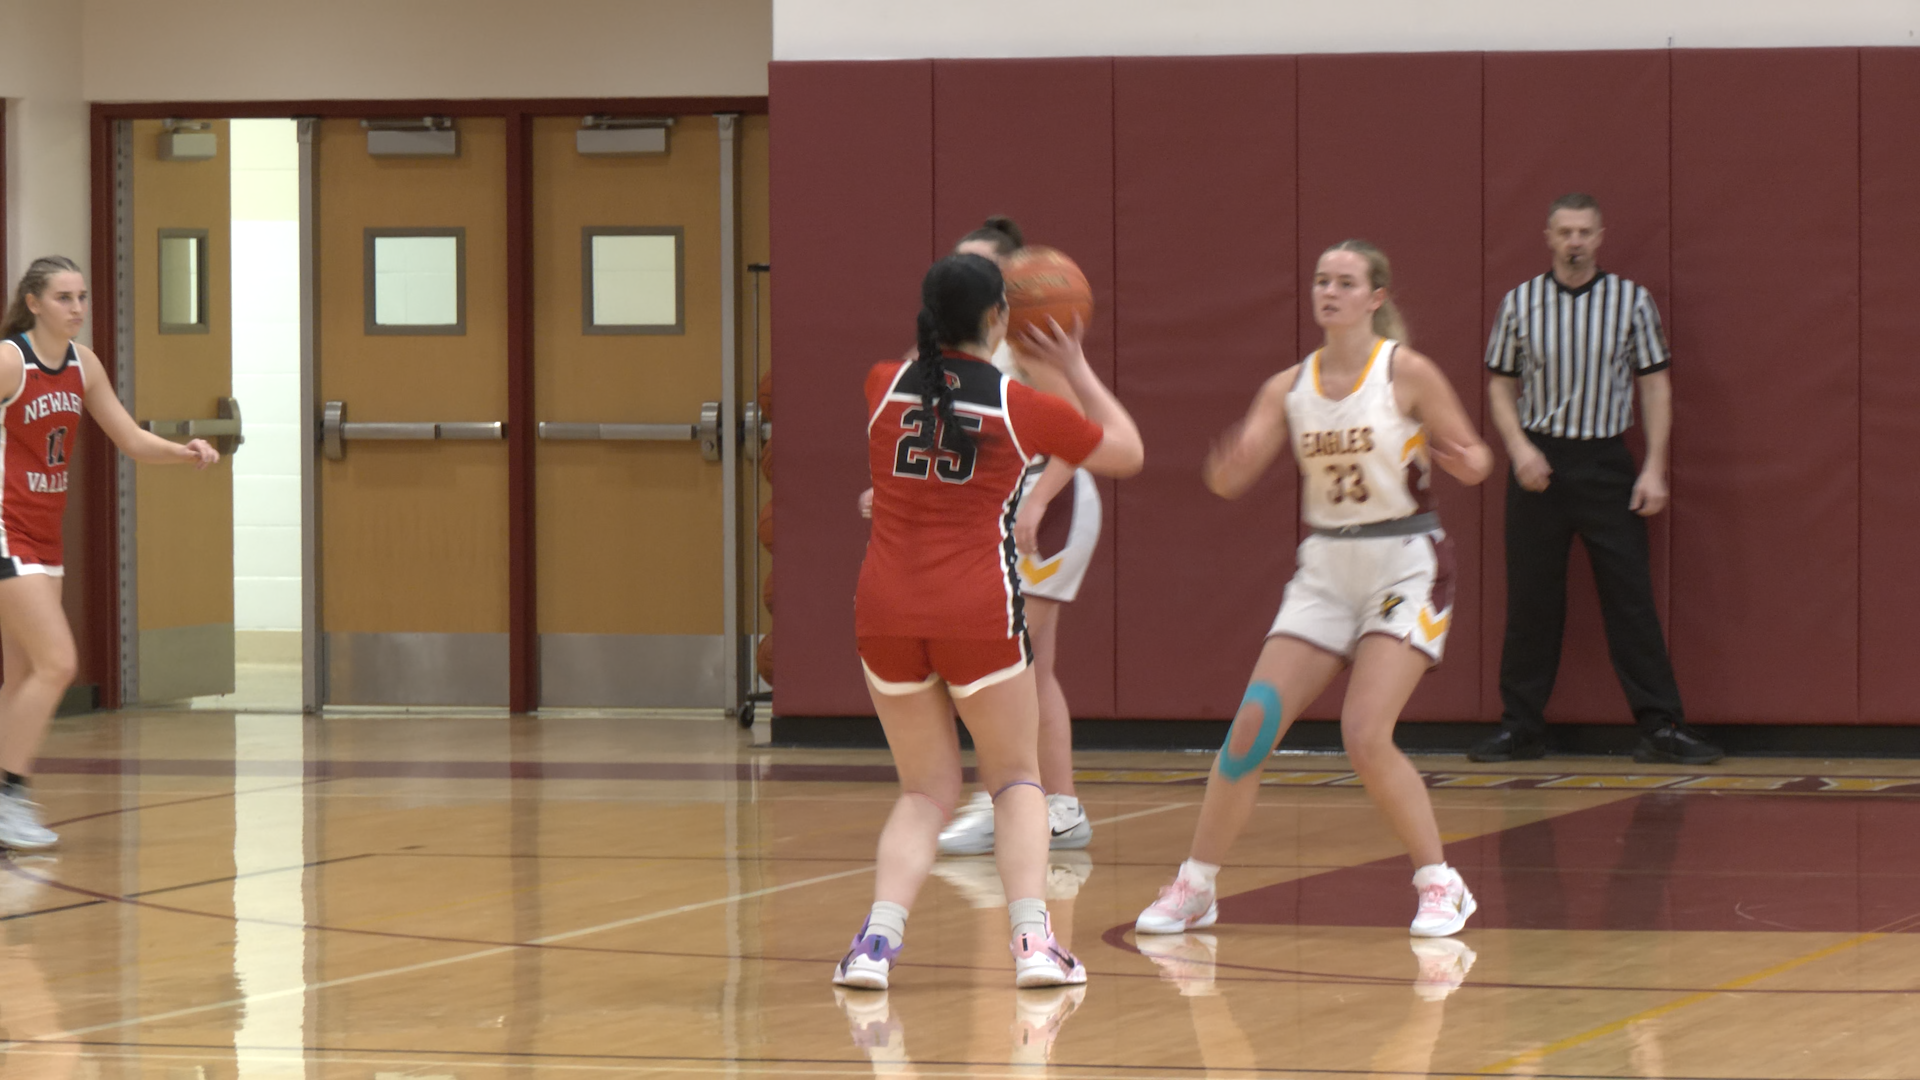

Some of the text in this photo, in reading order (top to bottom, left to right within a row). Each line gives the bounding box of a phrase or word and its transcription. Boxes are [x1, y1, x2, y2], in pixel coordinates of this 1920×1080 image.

[892, 405, 983, 485] 25
[1301, 426, 1376, 458] EAGLES
[1324, 463, 1370, 505] 33
